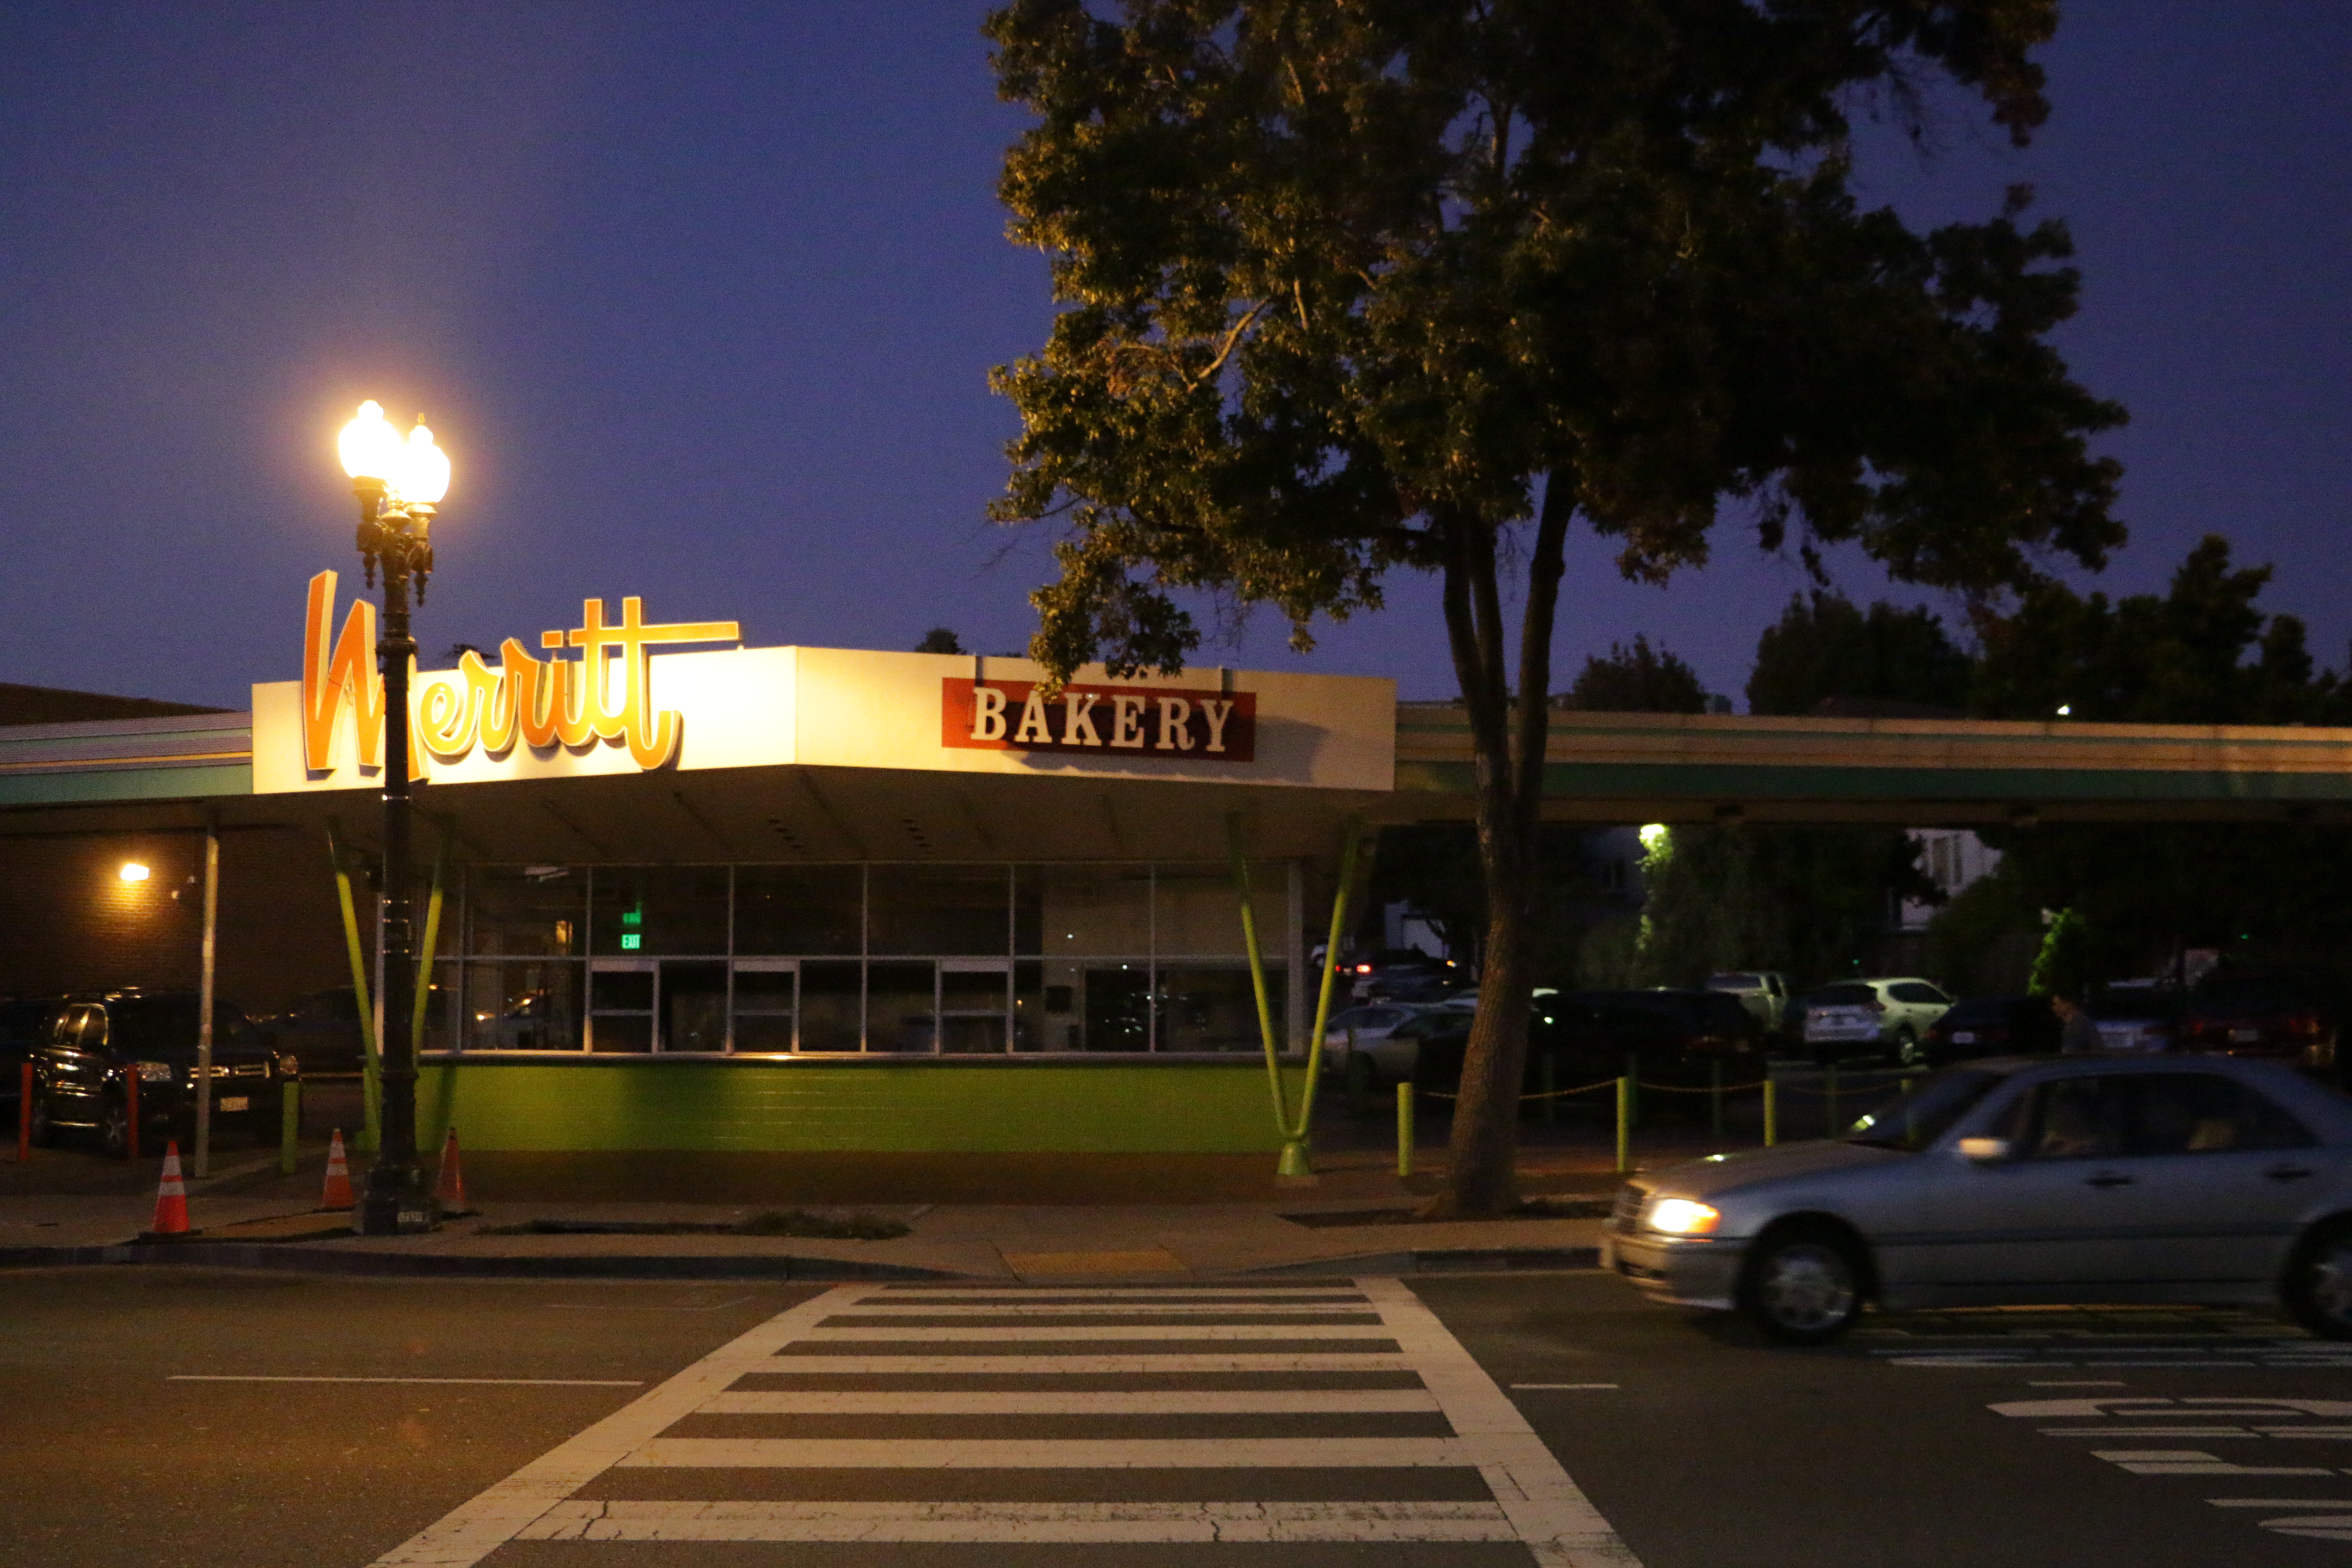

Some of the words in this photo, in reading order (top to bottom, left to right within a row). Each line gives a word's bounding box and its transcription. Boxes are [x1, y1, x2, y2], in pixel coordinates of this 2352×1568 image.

[303, 570, 738, 781] Merritt
[970, 687, 1234, 752] BAKERY
[622, 934, 640, 949] EXIT
